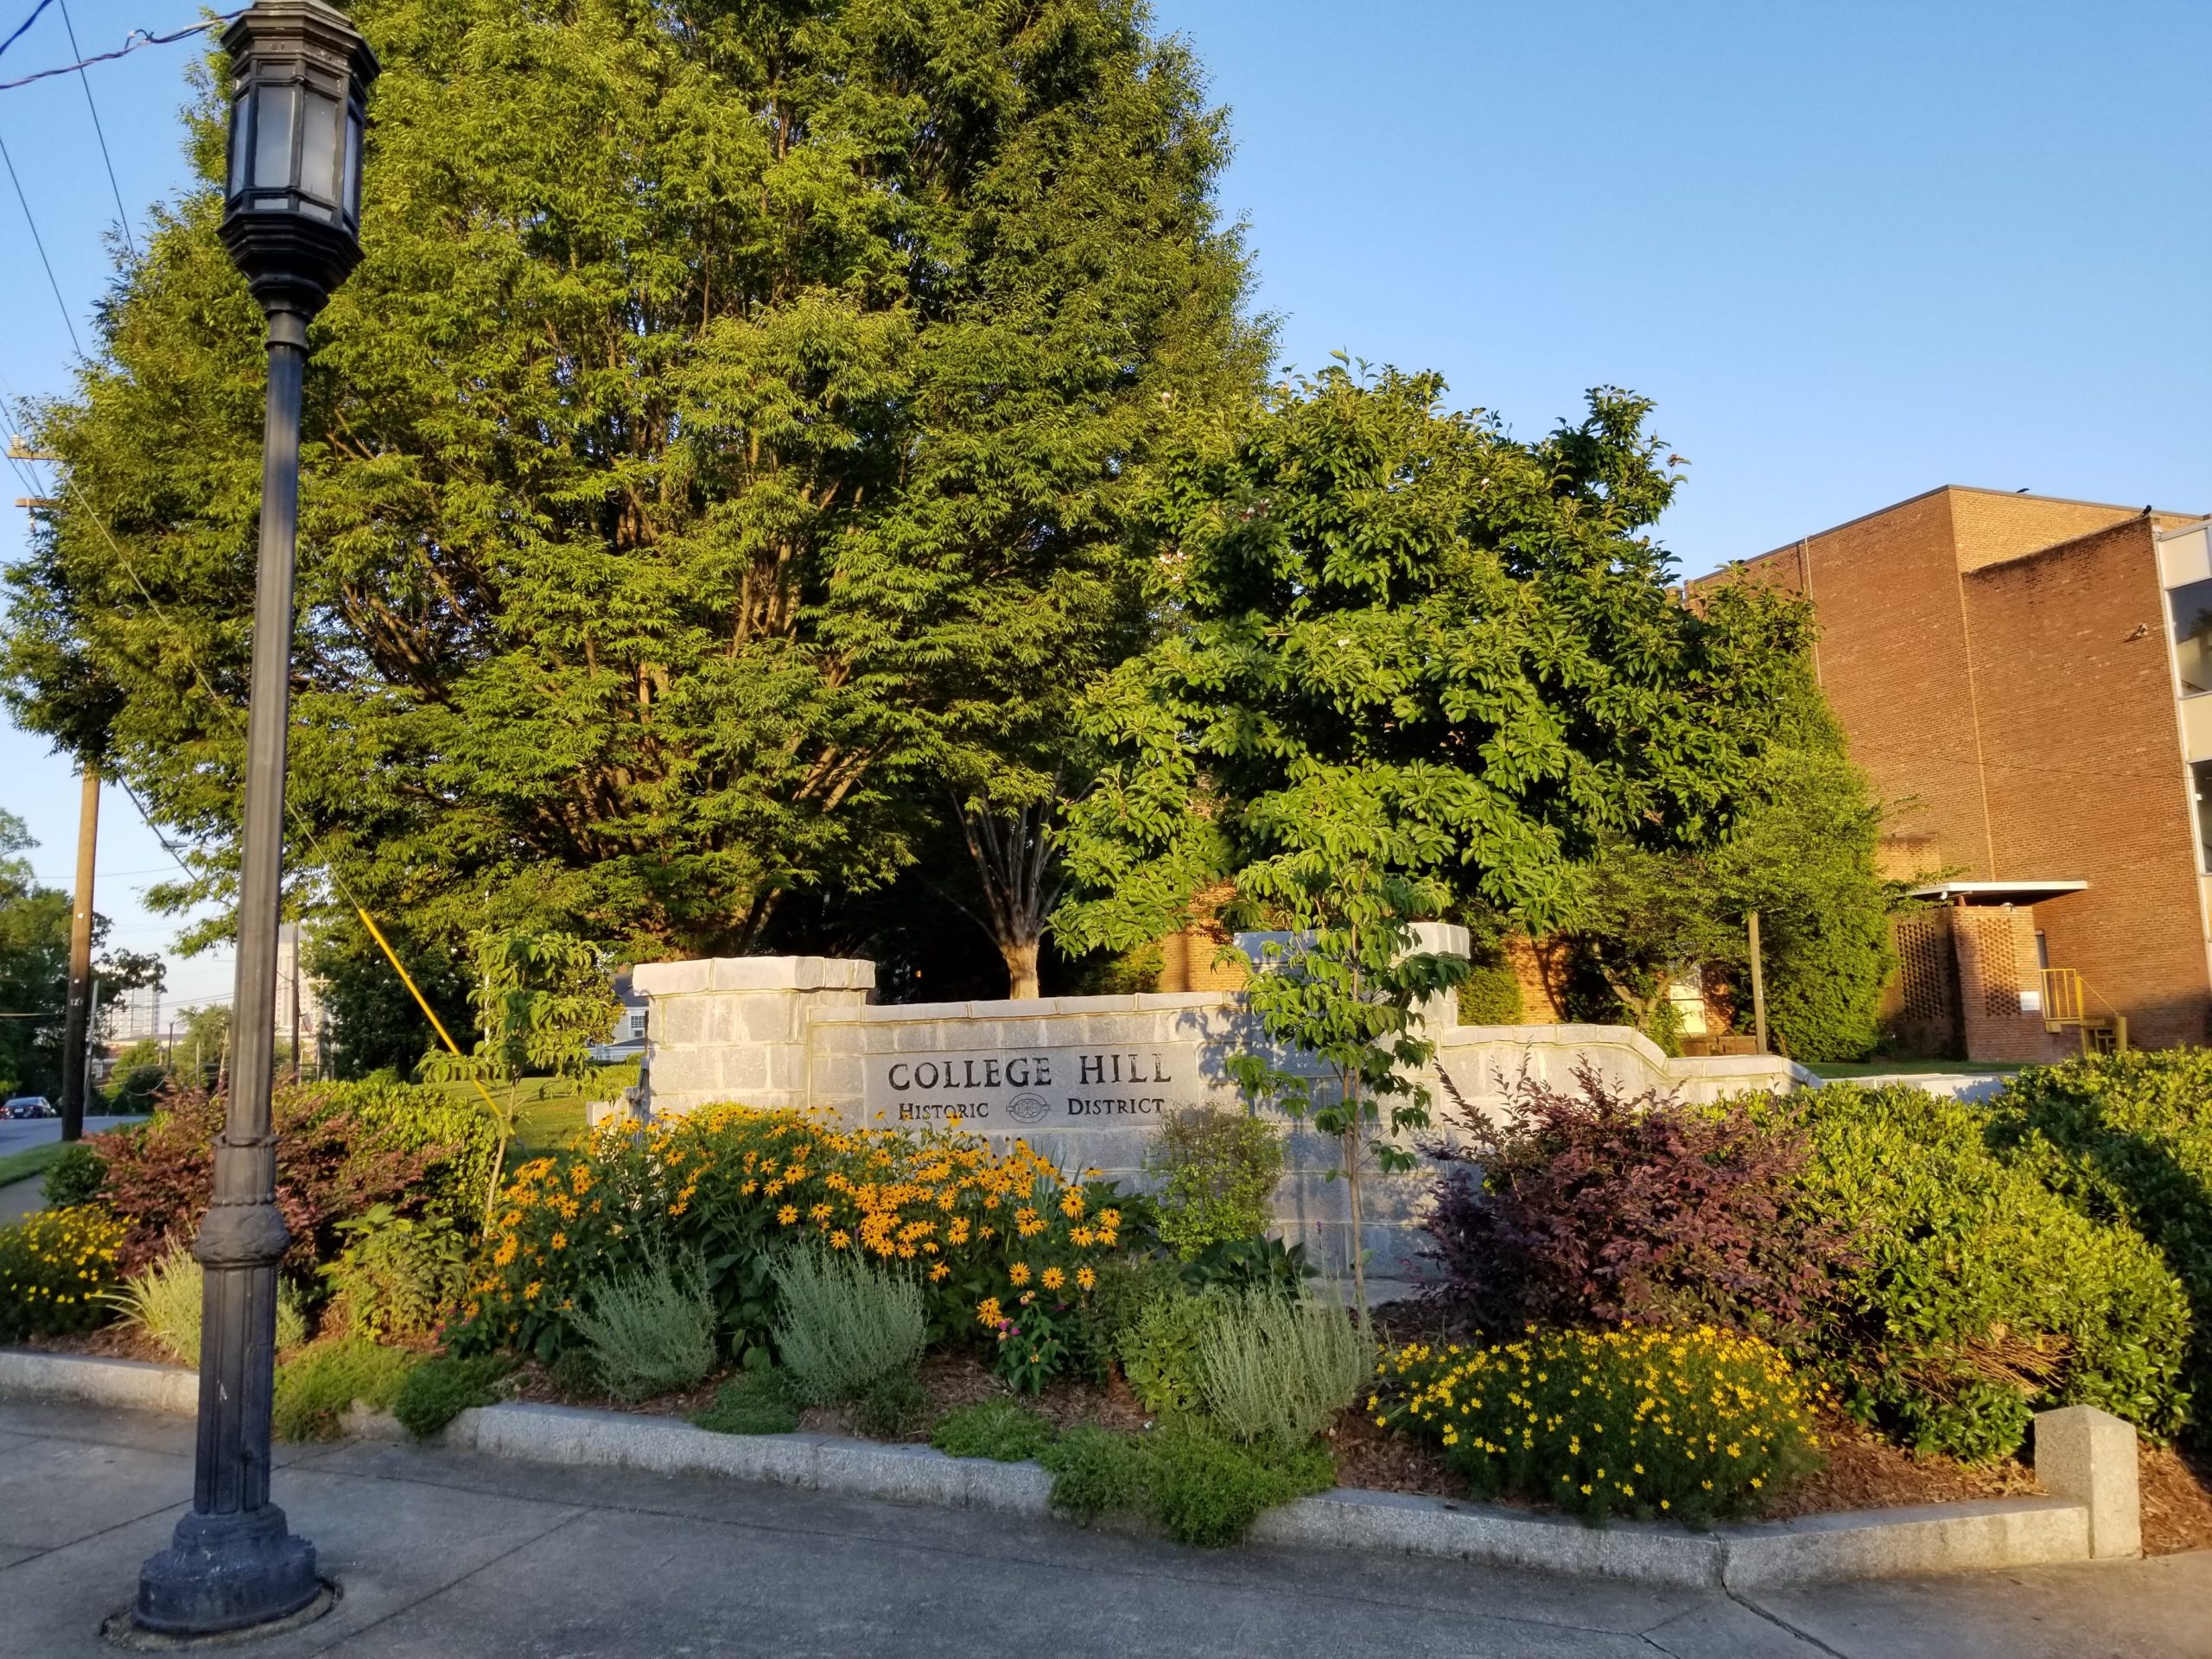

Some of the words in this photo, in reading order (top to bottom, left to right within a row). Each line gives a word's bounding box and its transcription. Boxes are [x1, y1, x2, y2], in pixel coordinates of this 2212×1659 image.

[888, 1057, 1052, 1090] COLLEGE
[1079, 1053, 1172, 1084] HILL
[899, 1103, 989, 1121] HISTORIC
[1067, 1097, 1165, 1116] DISTRICT
